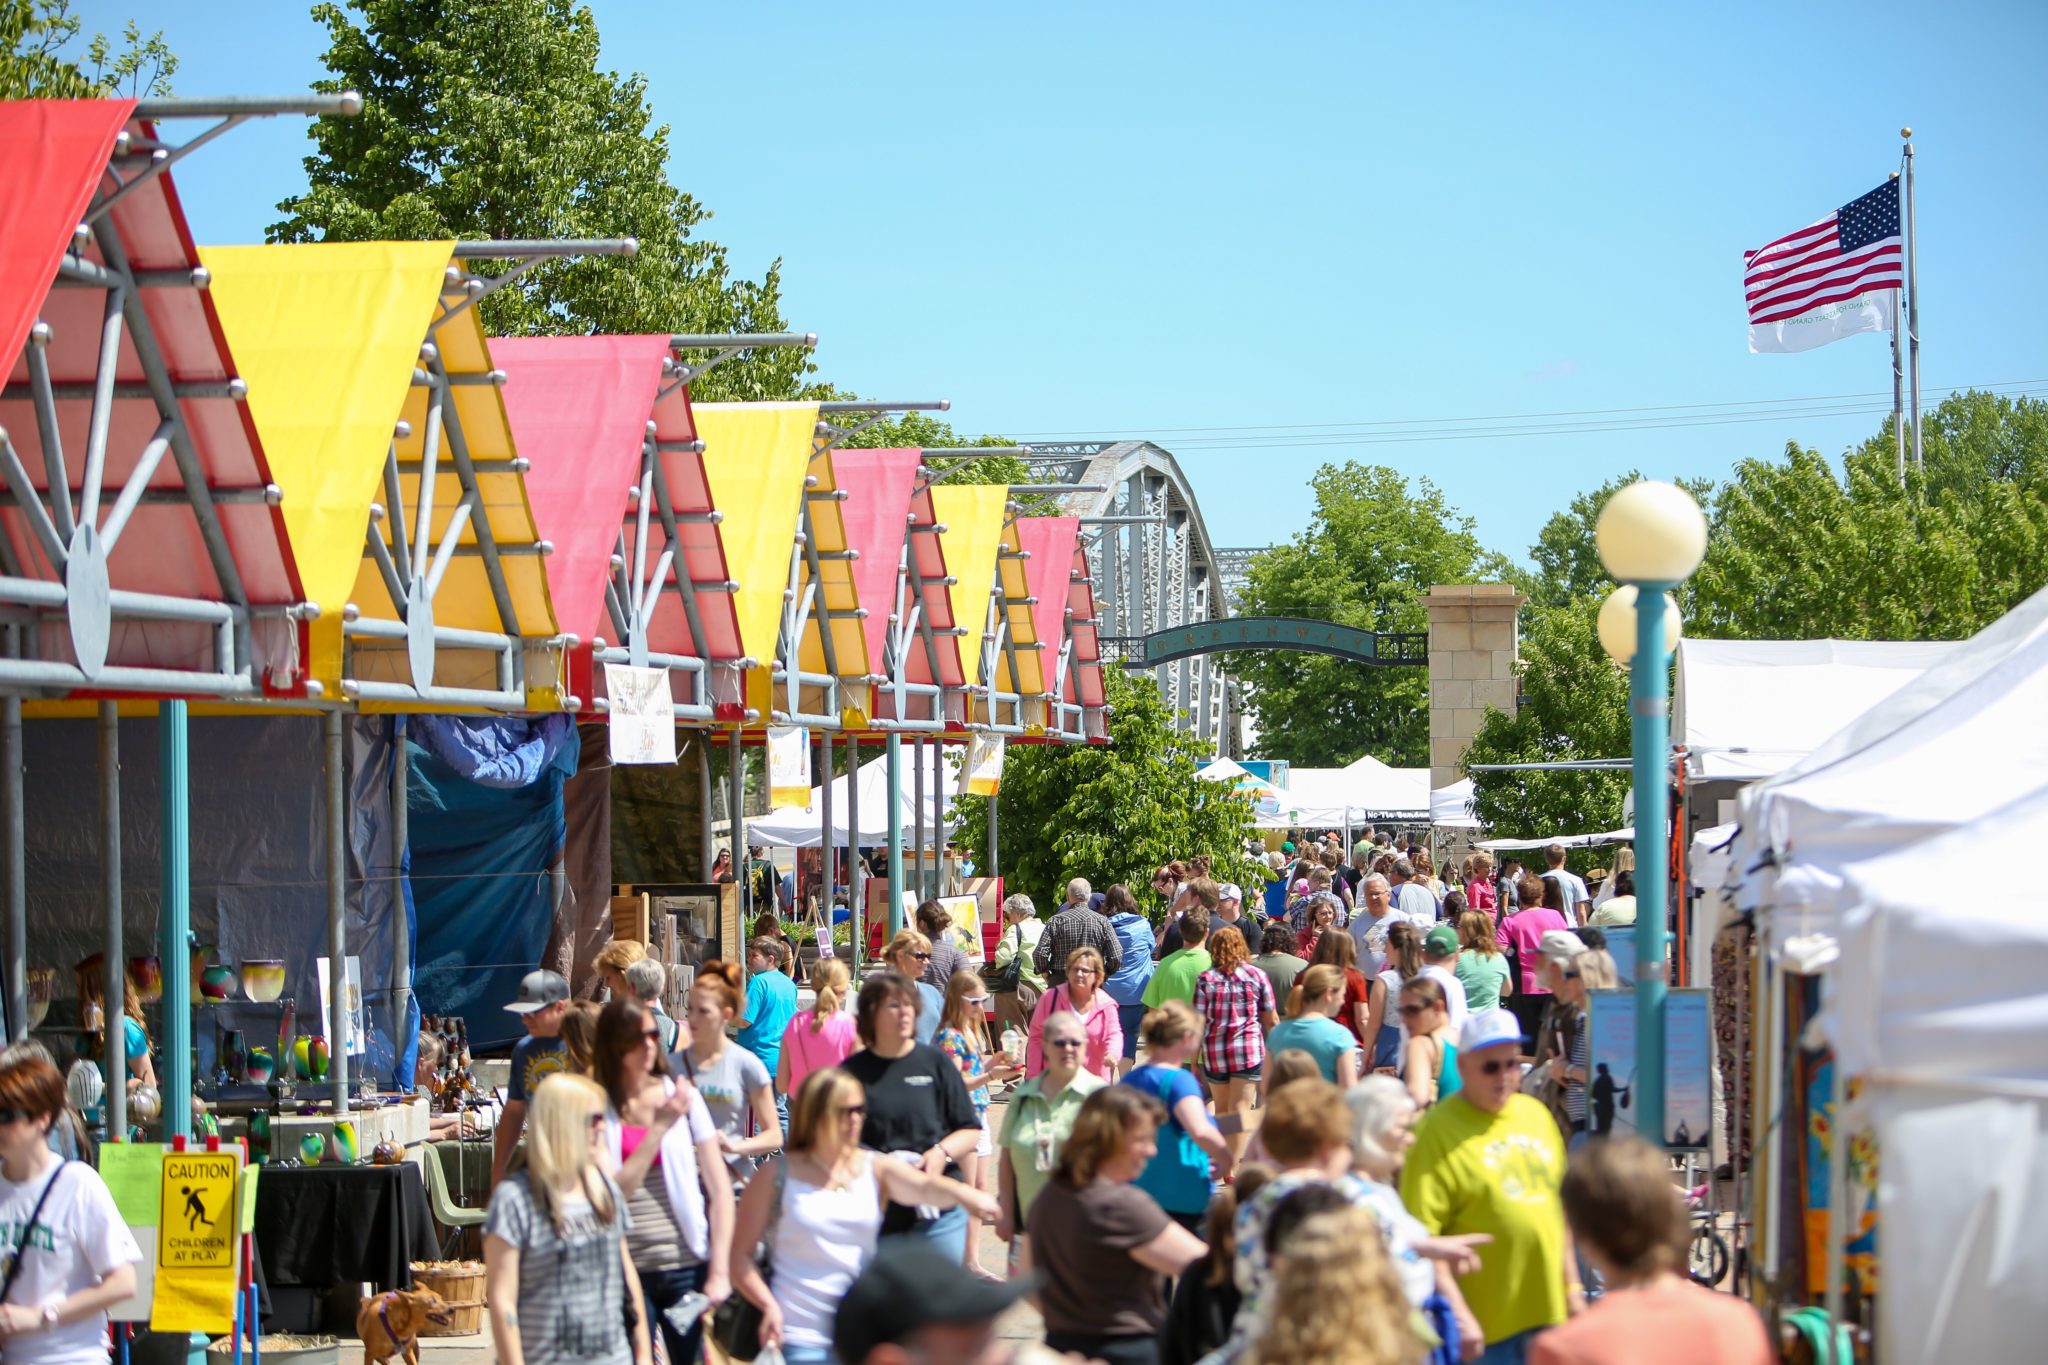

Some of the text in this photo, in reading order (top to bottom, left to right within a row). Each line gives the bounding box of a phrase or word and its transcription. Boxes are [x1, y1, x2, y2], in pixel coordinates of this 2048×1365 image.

[168, 1163, 230, 1179] CAUTION
[169, 1237, 225, 1248] CHILDREN
[174, 1251, 219, 1261] AT PLAY
